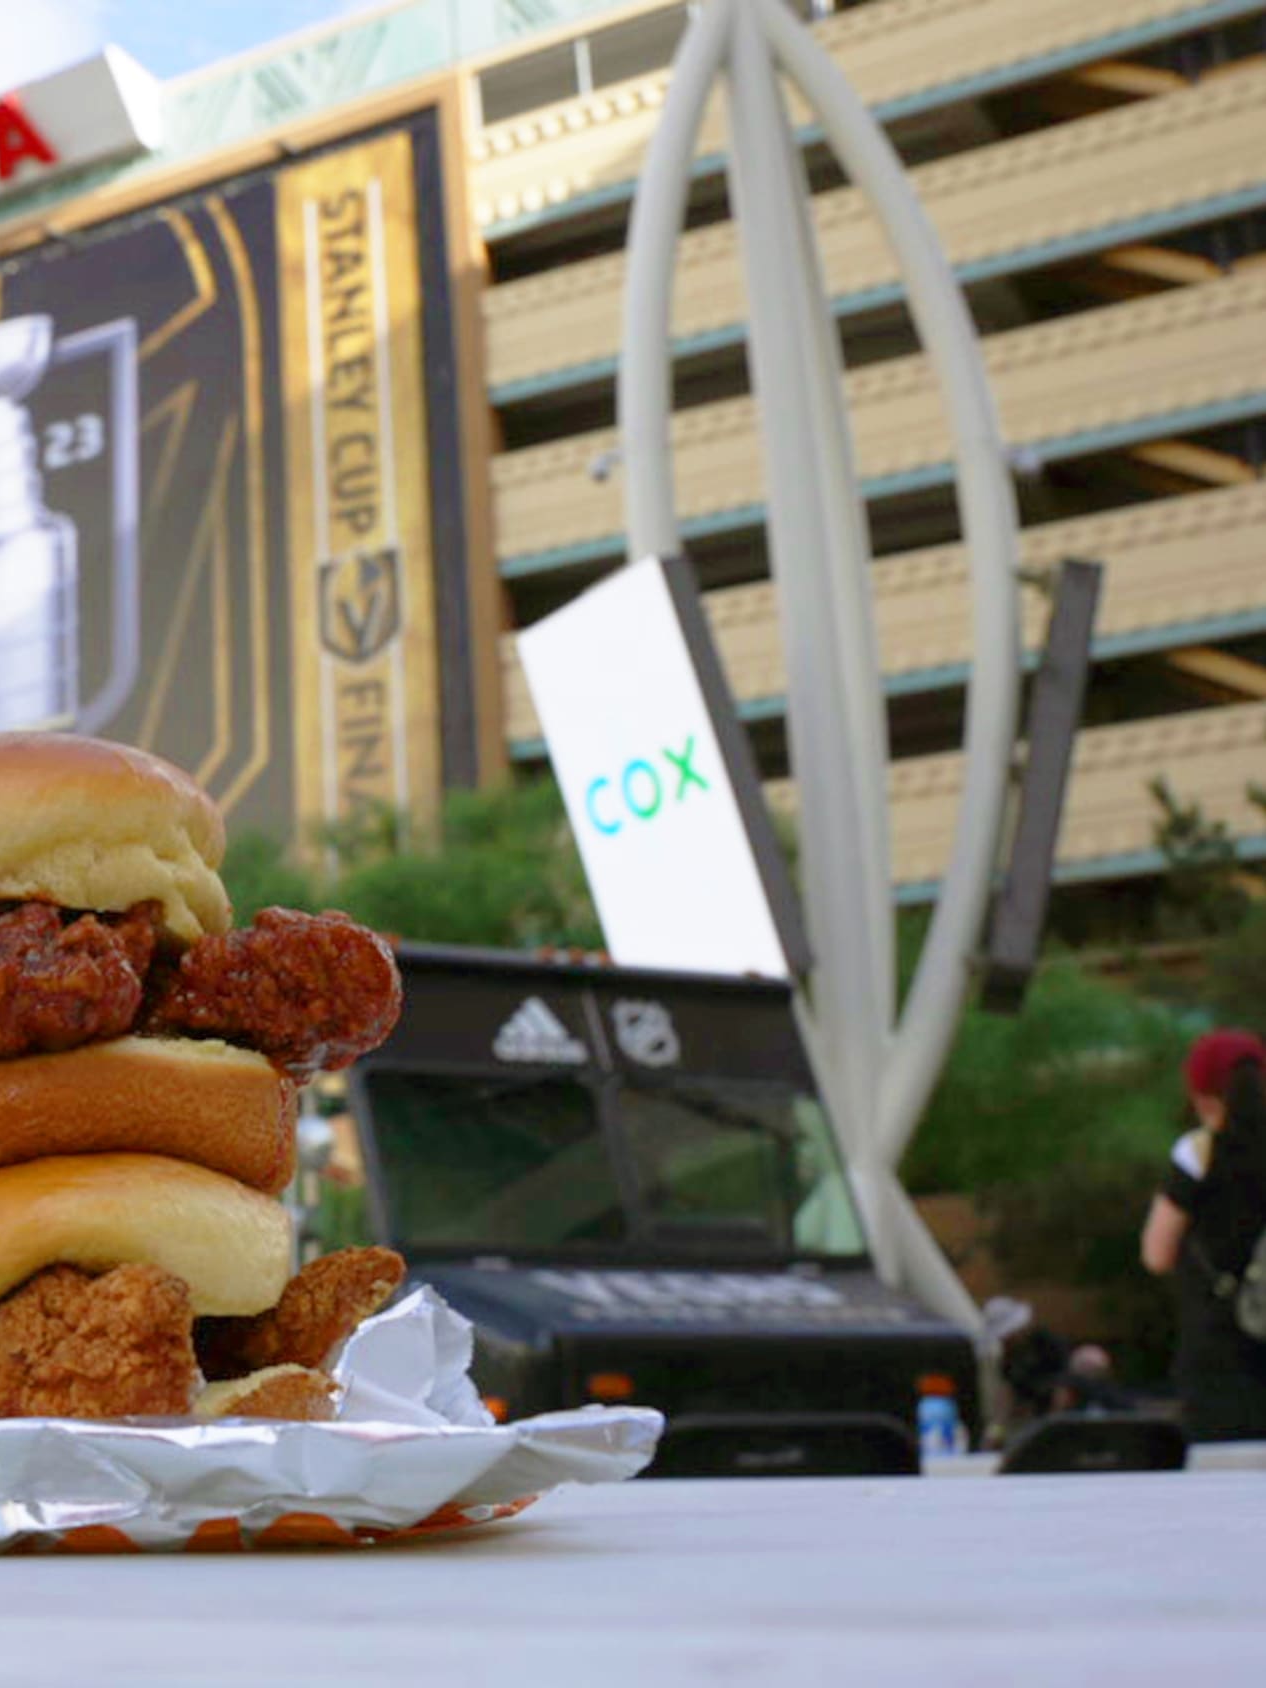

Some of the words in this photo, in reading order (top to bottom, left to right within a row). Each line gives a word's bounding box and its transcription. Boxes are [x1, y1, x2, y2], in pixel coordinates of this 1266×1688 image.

[318, 187, 375, 412] STANLEY
[44, 412, 104, 469] 23
[328, 432, 378, 537] CUP
[340, 680, 386, 806] FIN
[585, 735, 711, 836] COX
